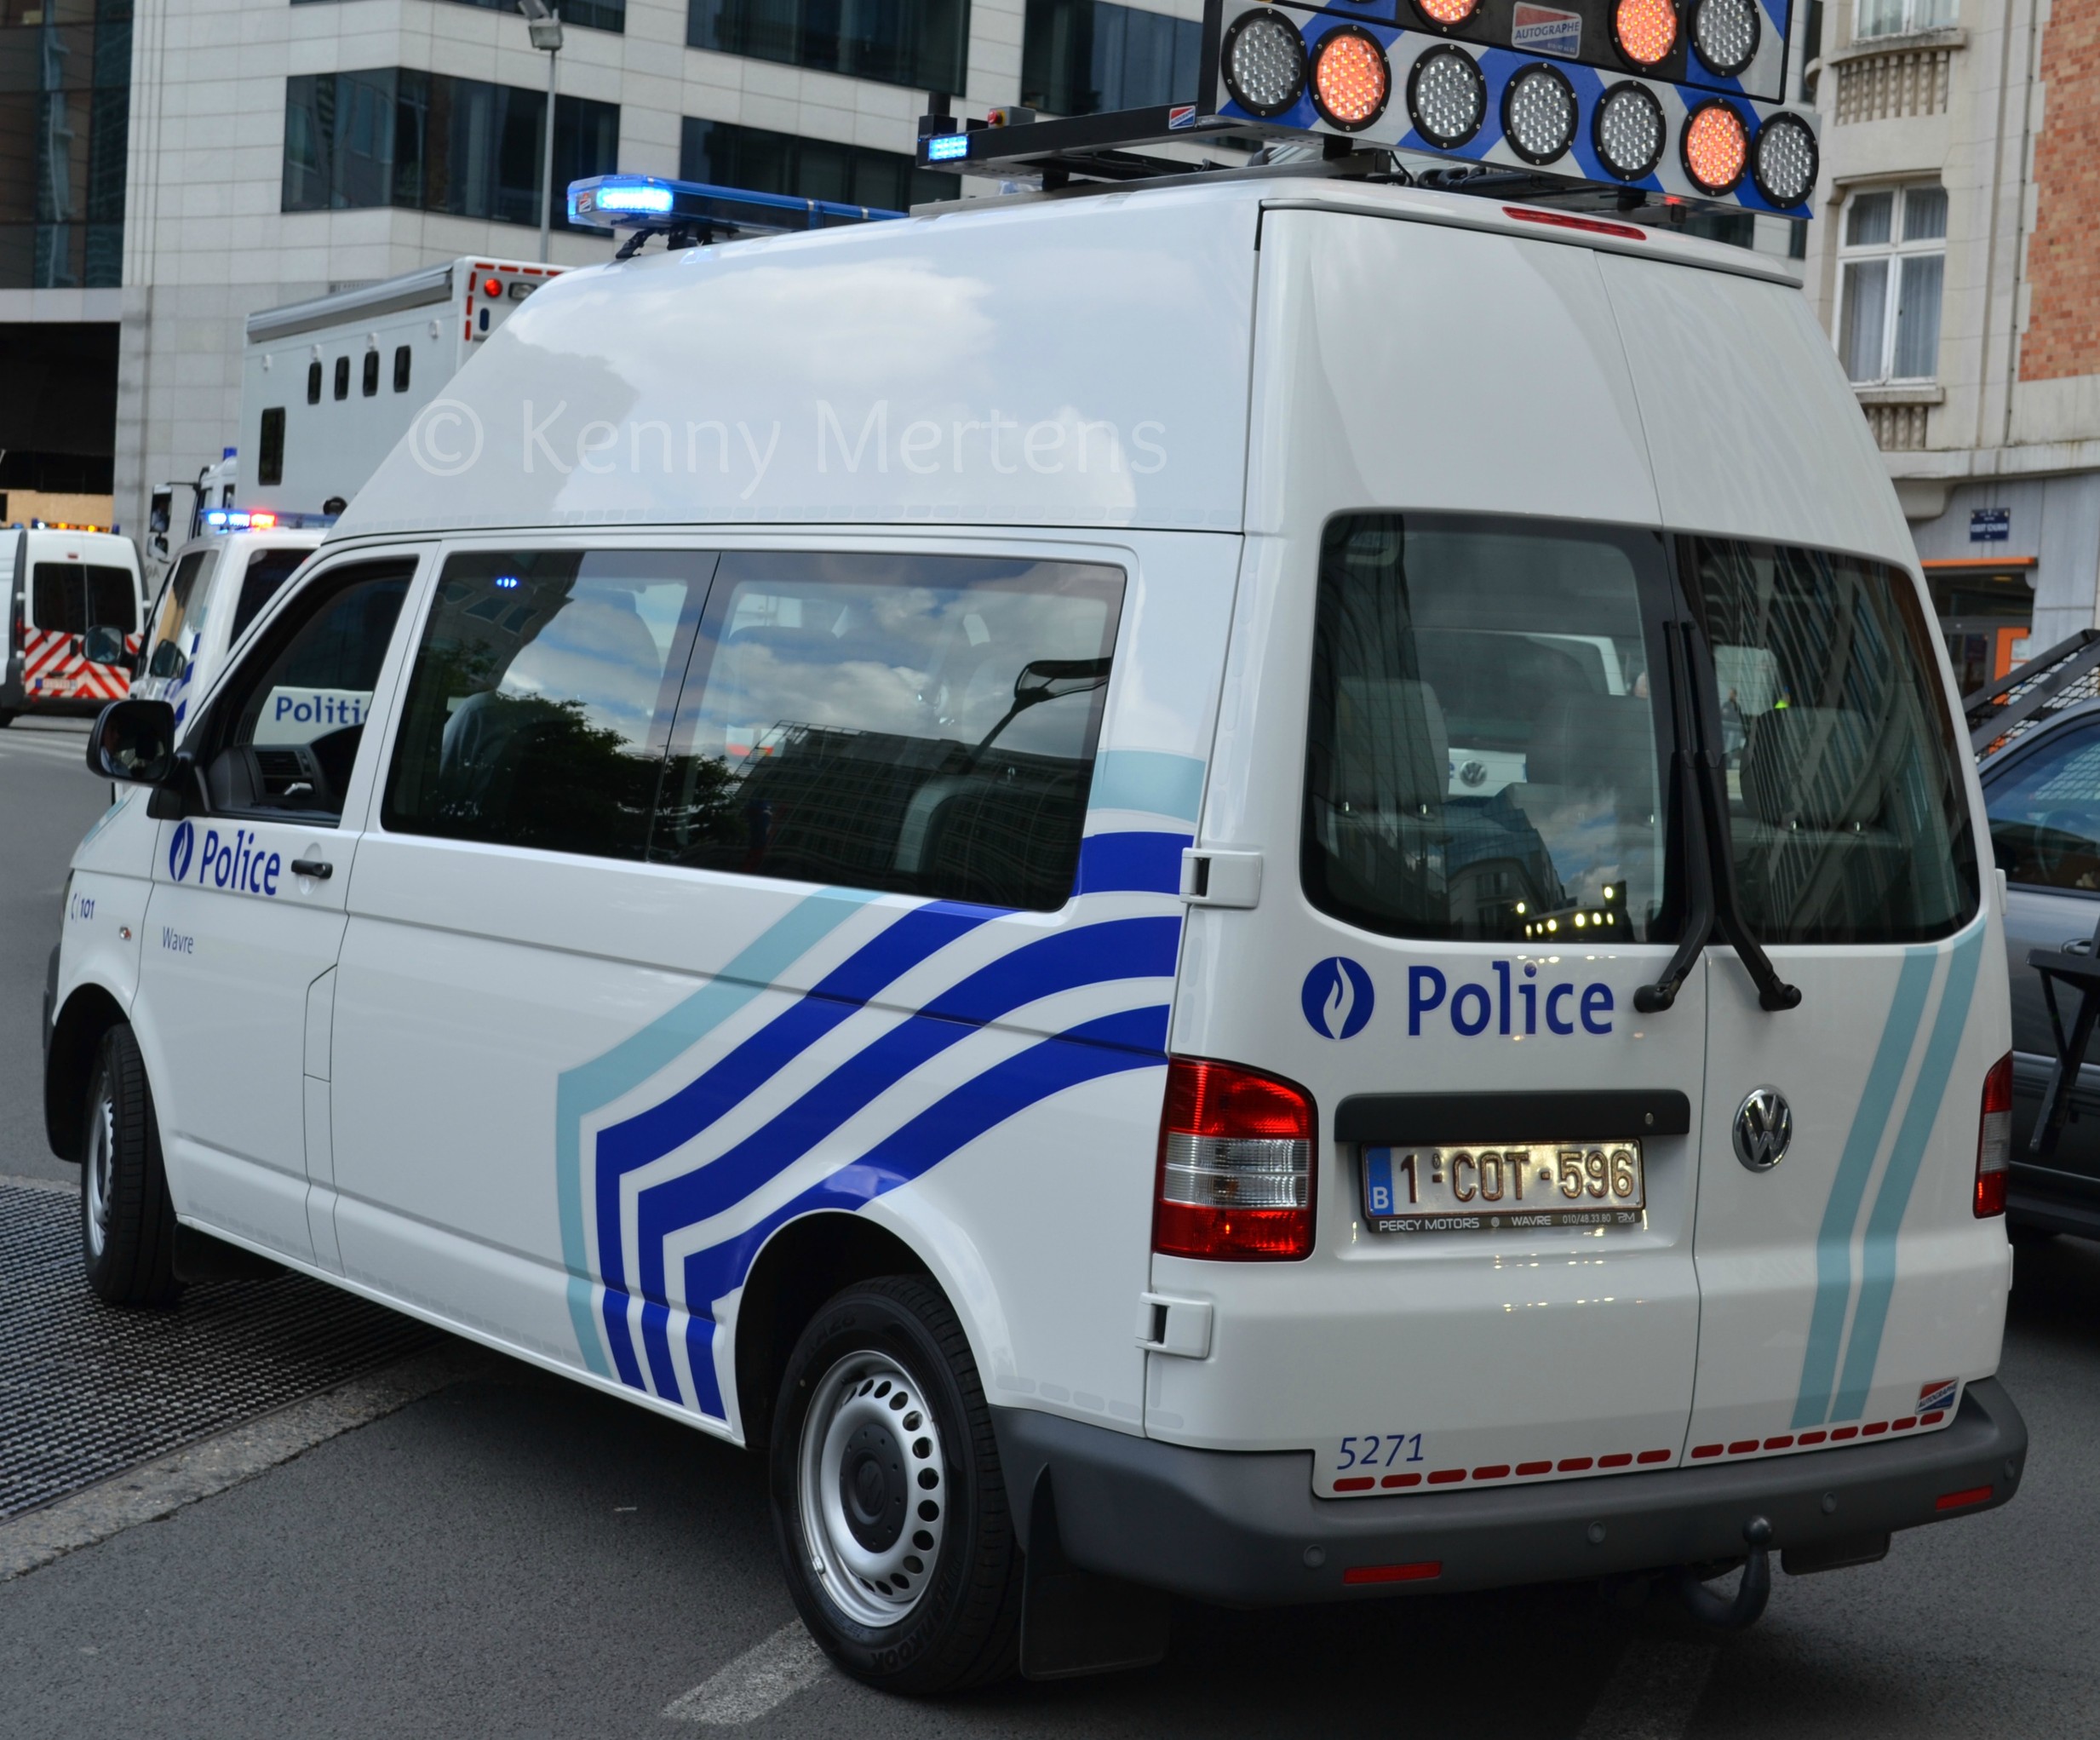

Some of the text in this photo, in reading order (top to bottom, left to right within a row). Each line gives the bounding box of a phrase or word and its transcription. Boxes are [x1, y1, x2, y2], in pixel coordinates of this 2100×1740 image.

[1514, 21, 1581, 40] AUTOGRAPHE
[275, 695, 370, 724] Politi
[199, 830, 280, 896] Police
[80, 899, 95, 920] 101
[162, 926, 194, 955] Wavre
[1408, 960, 1615, 1037] Police
[1373, 1186, 1389, 1209] B
[1379, 1220, 1422, 1232] PERCY
[1425, 1217, 1480, 1231] MOTORS
[1511, 1215, 1552, 1226] WAVRE
[1562, 1214, 1612, 1225] 010/48.33.80
[1337, 1433, 1424, 1470] 5271
